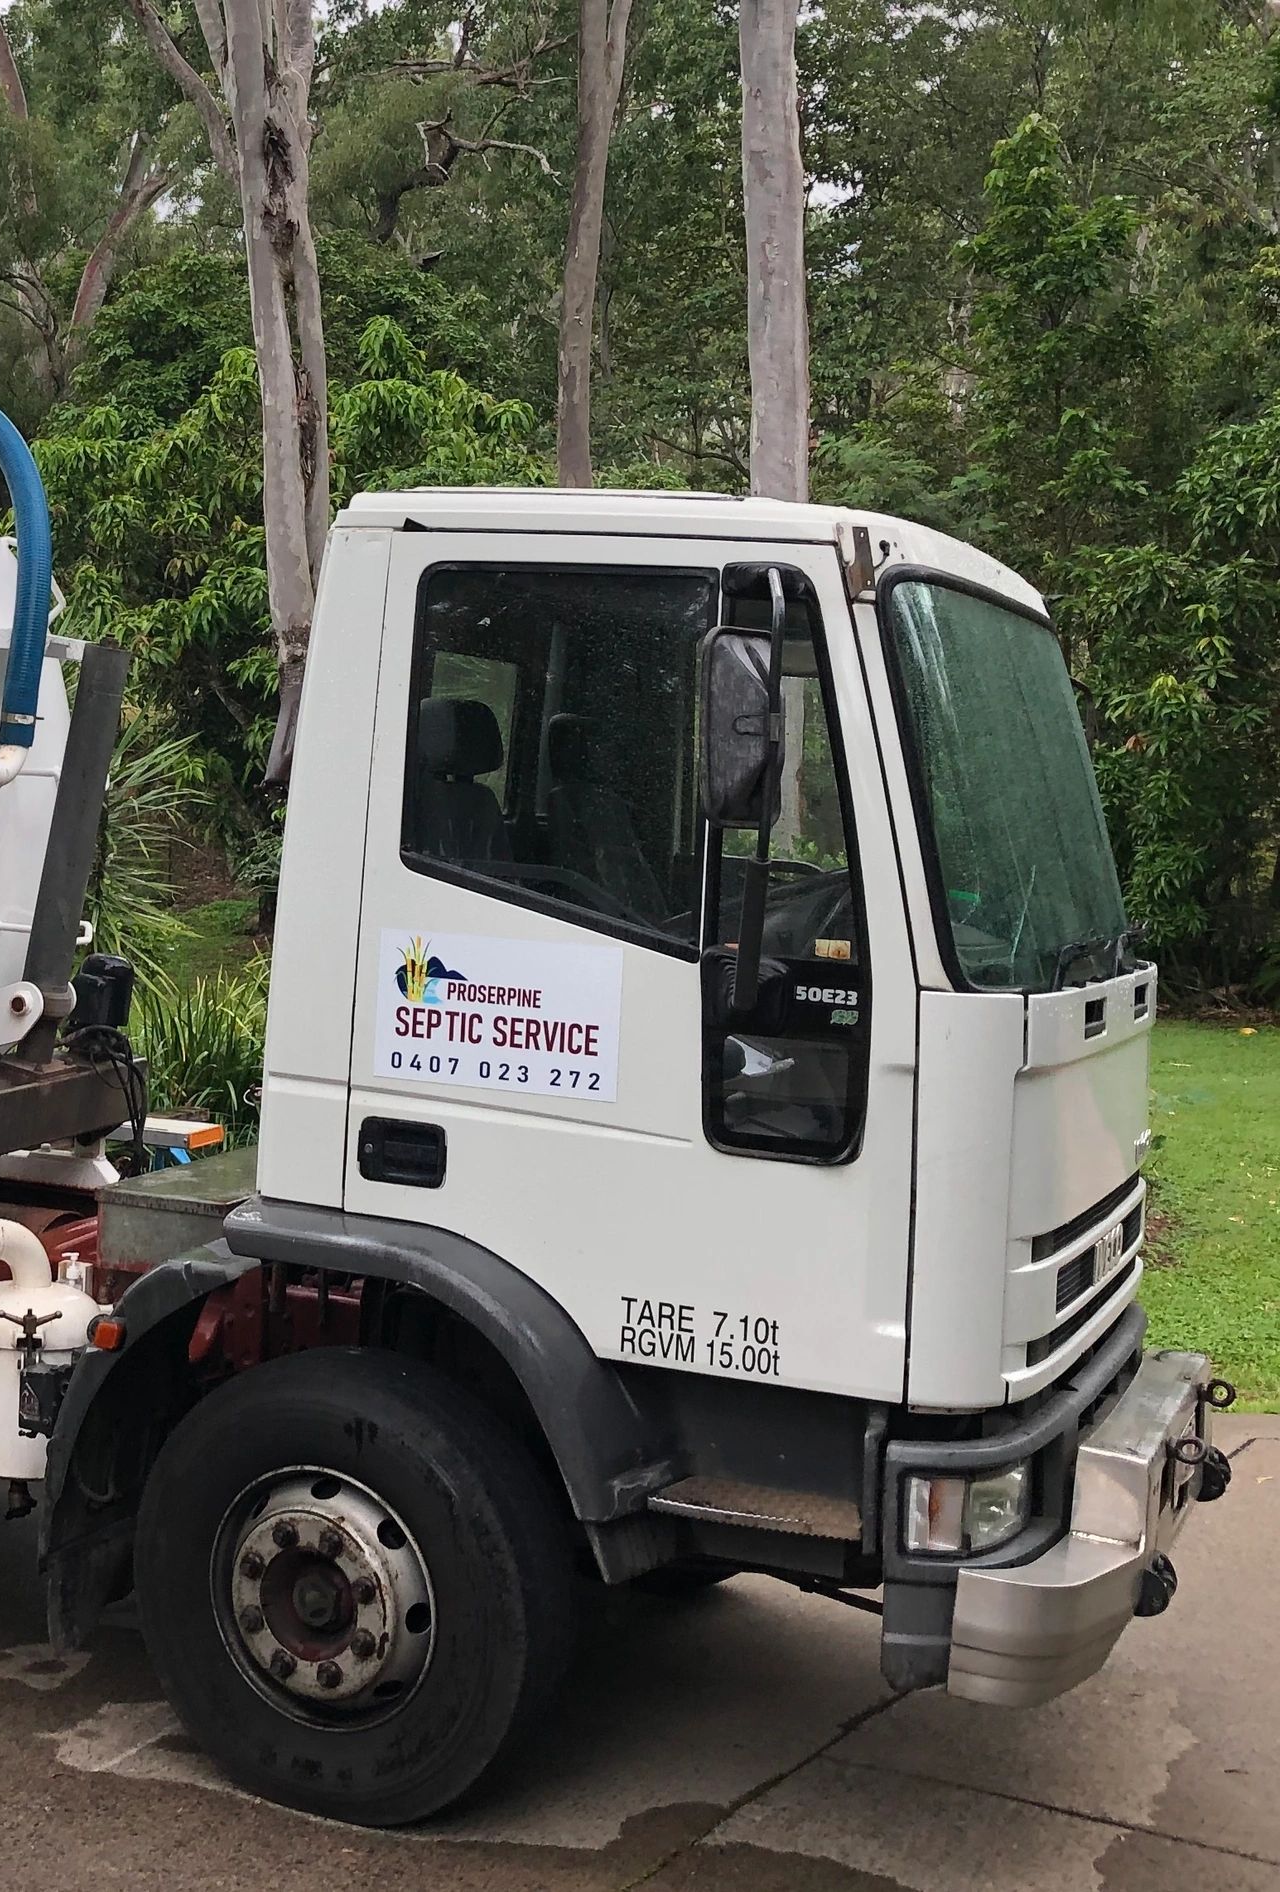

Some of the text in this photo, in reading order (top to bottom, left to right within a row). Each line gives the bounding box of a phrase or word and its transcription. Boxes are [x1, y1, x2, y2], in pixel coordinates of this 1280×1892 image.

[447, 981, 542, 1009] PROSERPINE
[395, 1006, 600, 1057] SEPTIC SERVICE
[391, 1051, 600, 1091] 0407 023 272
[620, 1296, 780, 1347] TARE 7.10t
[620, 1325, 781, 1377] RGVM 15.00t
